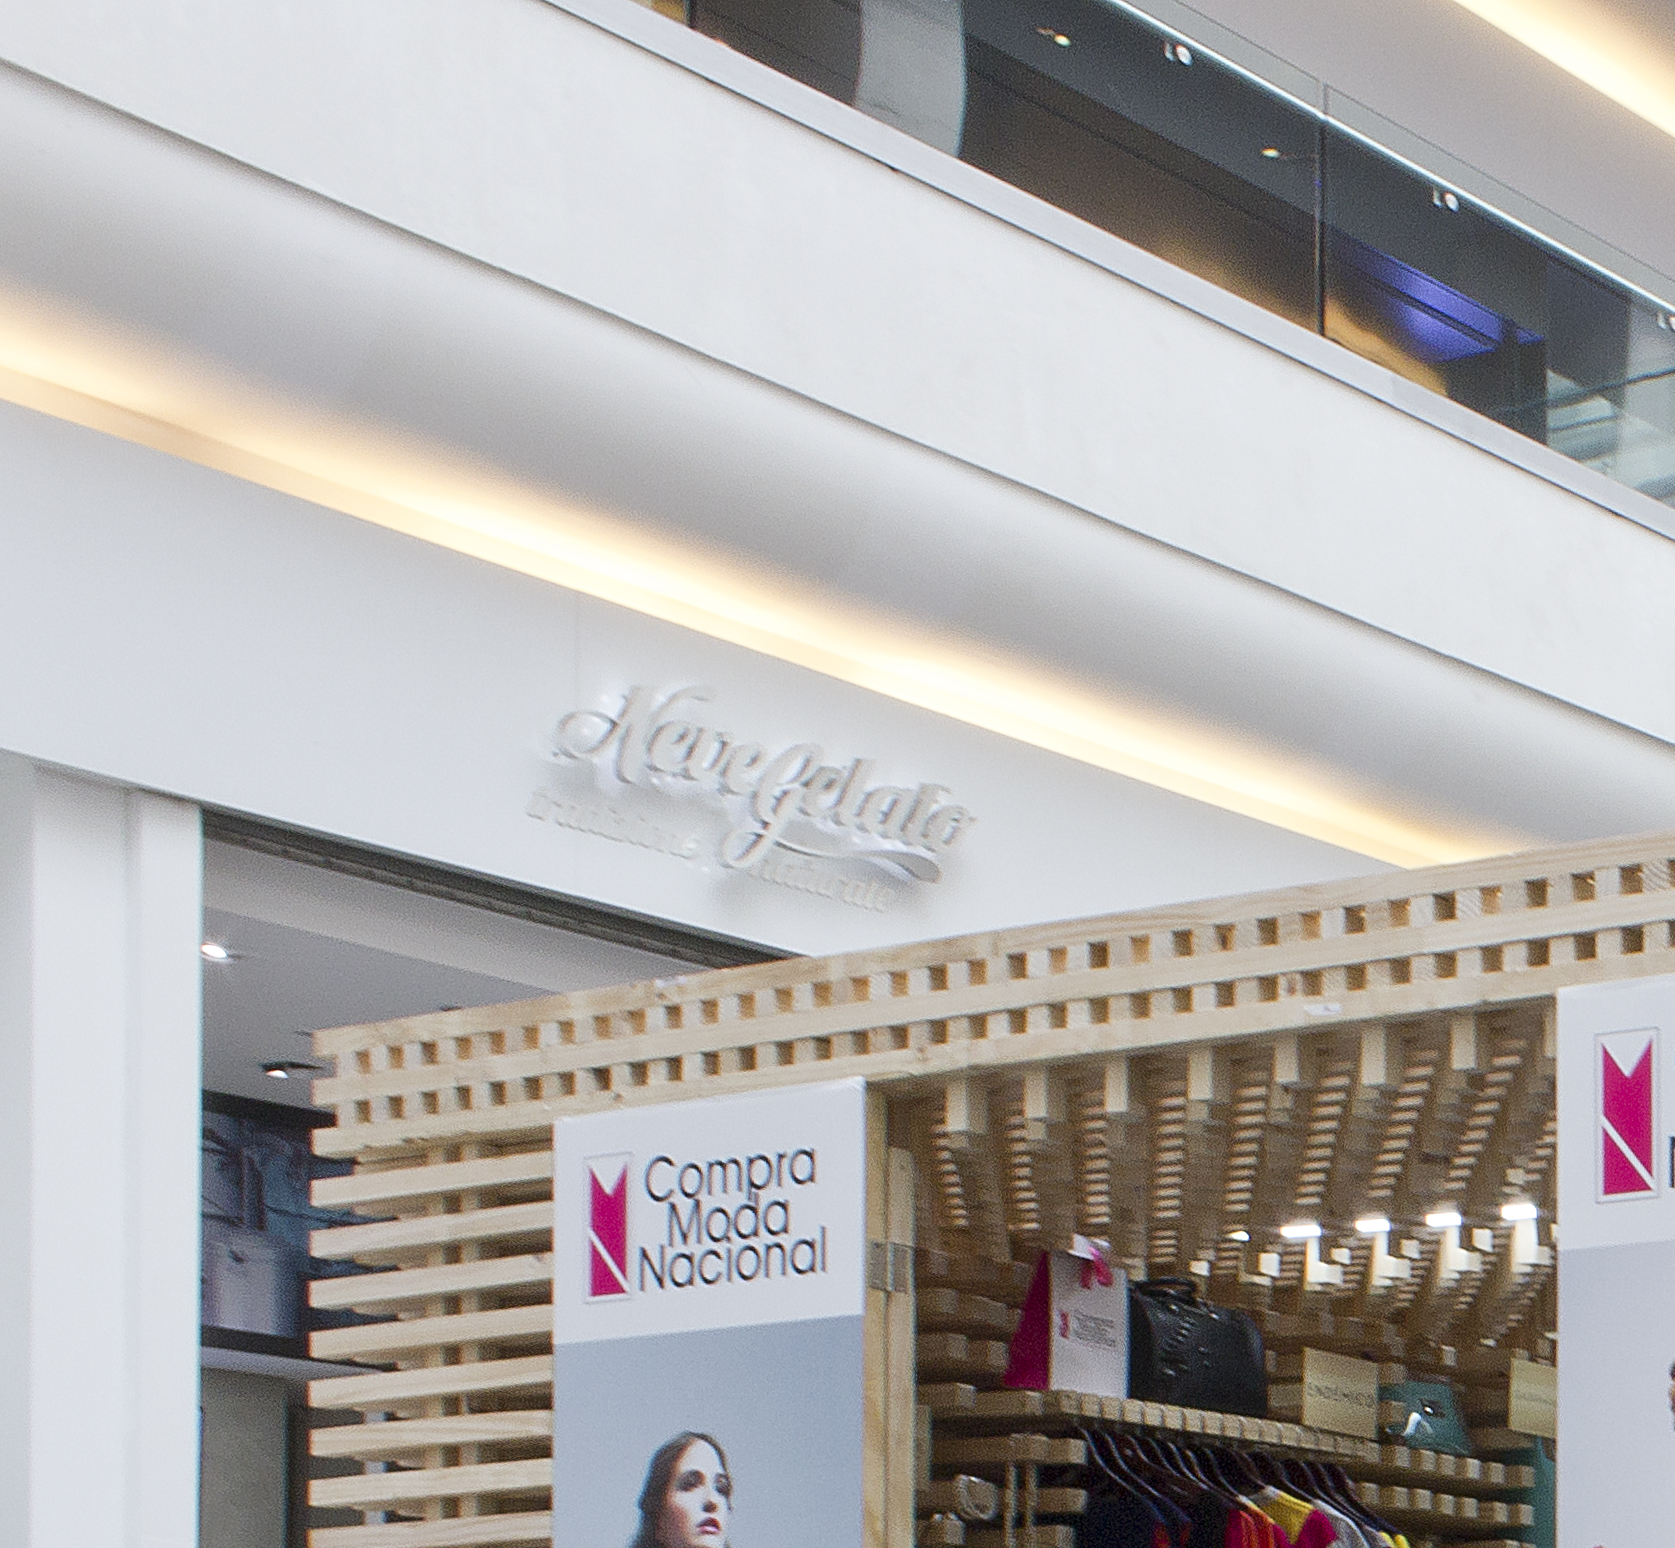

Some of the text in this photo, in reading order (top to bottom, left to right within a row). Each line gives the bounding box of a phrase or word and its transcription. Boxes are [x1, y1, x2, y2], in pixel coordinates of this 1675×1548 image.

[720, 742, 974, 884] Gelato
[643, 1147, 817, 1202] Compra
[666, 1192, 790, 1247] Moda
[637, 1225, 828, 1292] Nacional
